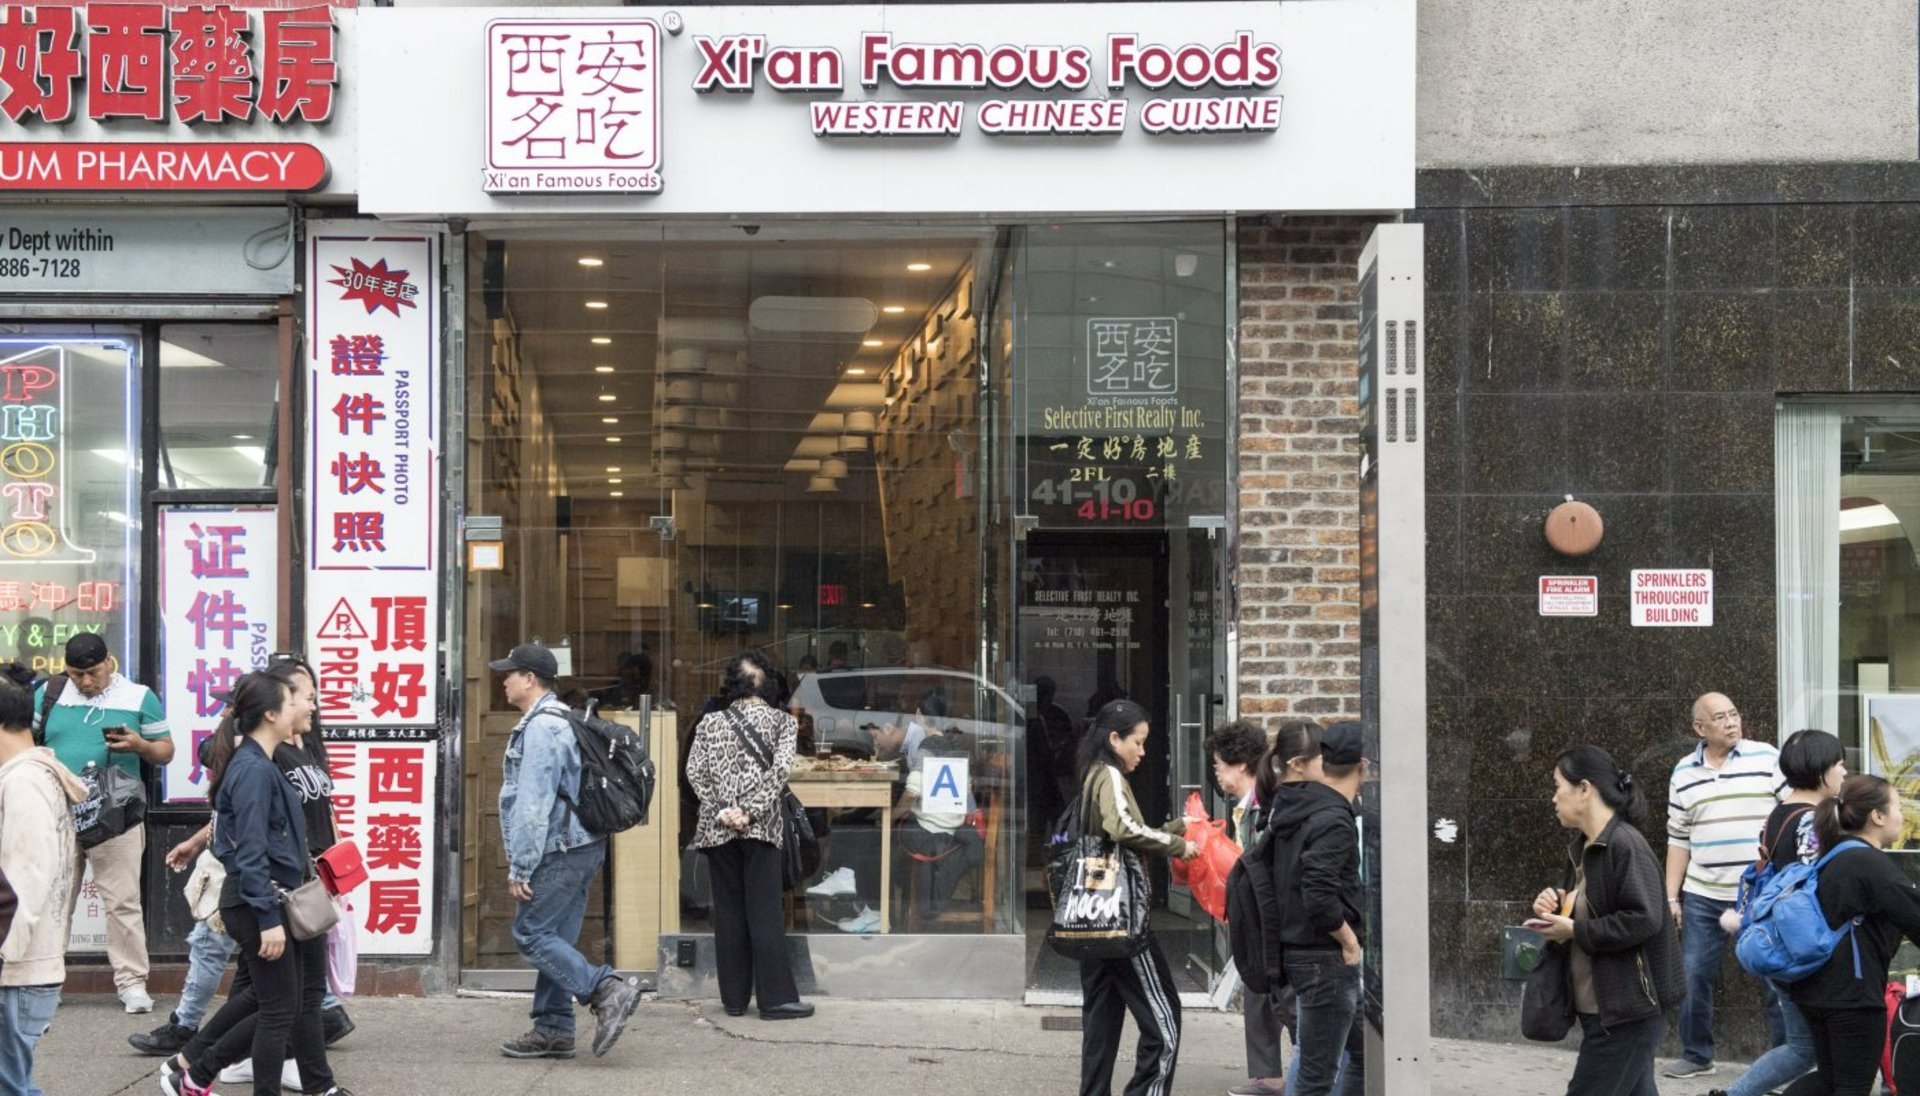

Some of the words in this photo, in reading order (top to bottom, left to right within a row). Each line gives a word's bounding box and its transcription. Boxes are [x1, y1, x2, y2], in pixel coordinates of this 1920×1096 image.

[696, 37, 840, 84] Xi'an
[864, 36, 1088, 84] Famous
[1111, 35, 1279, 83] Foods
[813, 104, 961, 130] WESTERN
[980, 102, 1123, 127] CHINESE
[1143, 100, 1279, 126] CUISINE
[77, 151, 295, 181] PHARMACY
[488, 173, 530, 188] Xi'an
[537, 173, 602, 188] Famous
[609, 173, 657, 188] Foods
[9, 227, 51, 256] Dept
[56, 228, 113, 251] within
[394, 370, 409, 449] PASSPORT
[1044, 405, 1101, 430] Selective
[1105, 406, 1134, 429] First
[1137, 405, 1175, 433] Realty
[1181, 406, 1205, 428] Inc.
[329, 334, 387, 553] 證件快照
[394, 454, 409, 506] PHOTO
[1070, 467, 1111, 482] 2FL
[1077, 498, 1154, 520] 41-10
[1637, 573, 1706, 587] SPRINKLERS
[1635, 591, 1709, 605] THROUGHOUT
[1646, 608, 1698, 622] BUILDING
[929, 764, 960, 798] A
